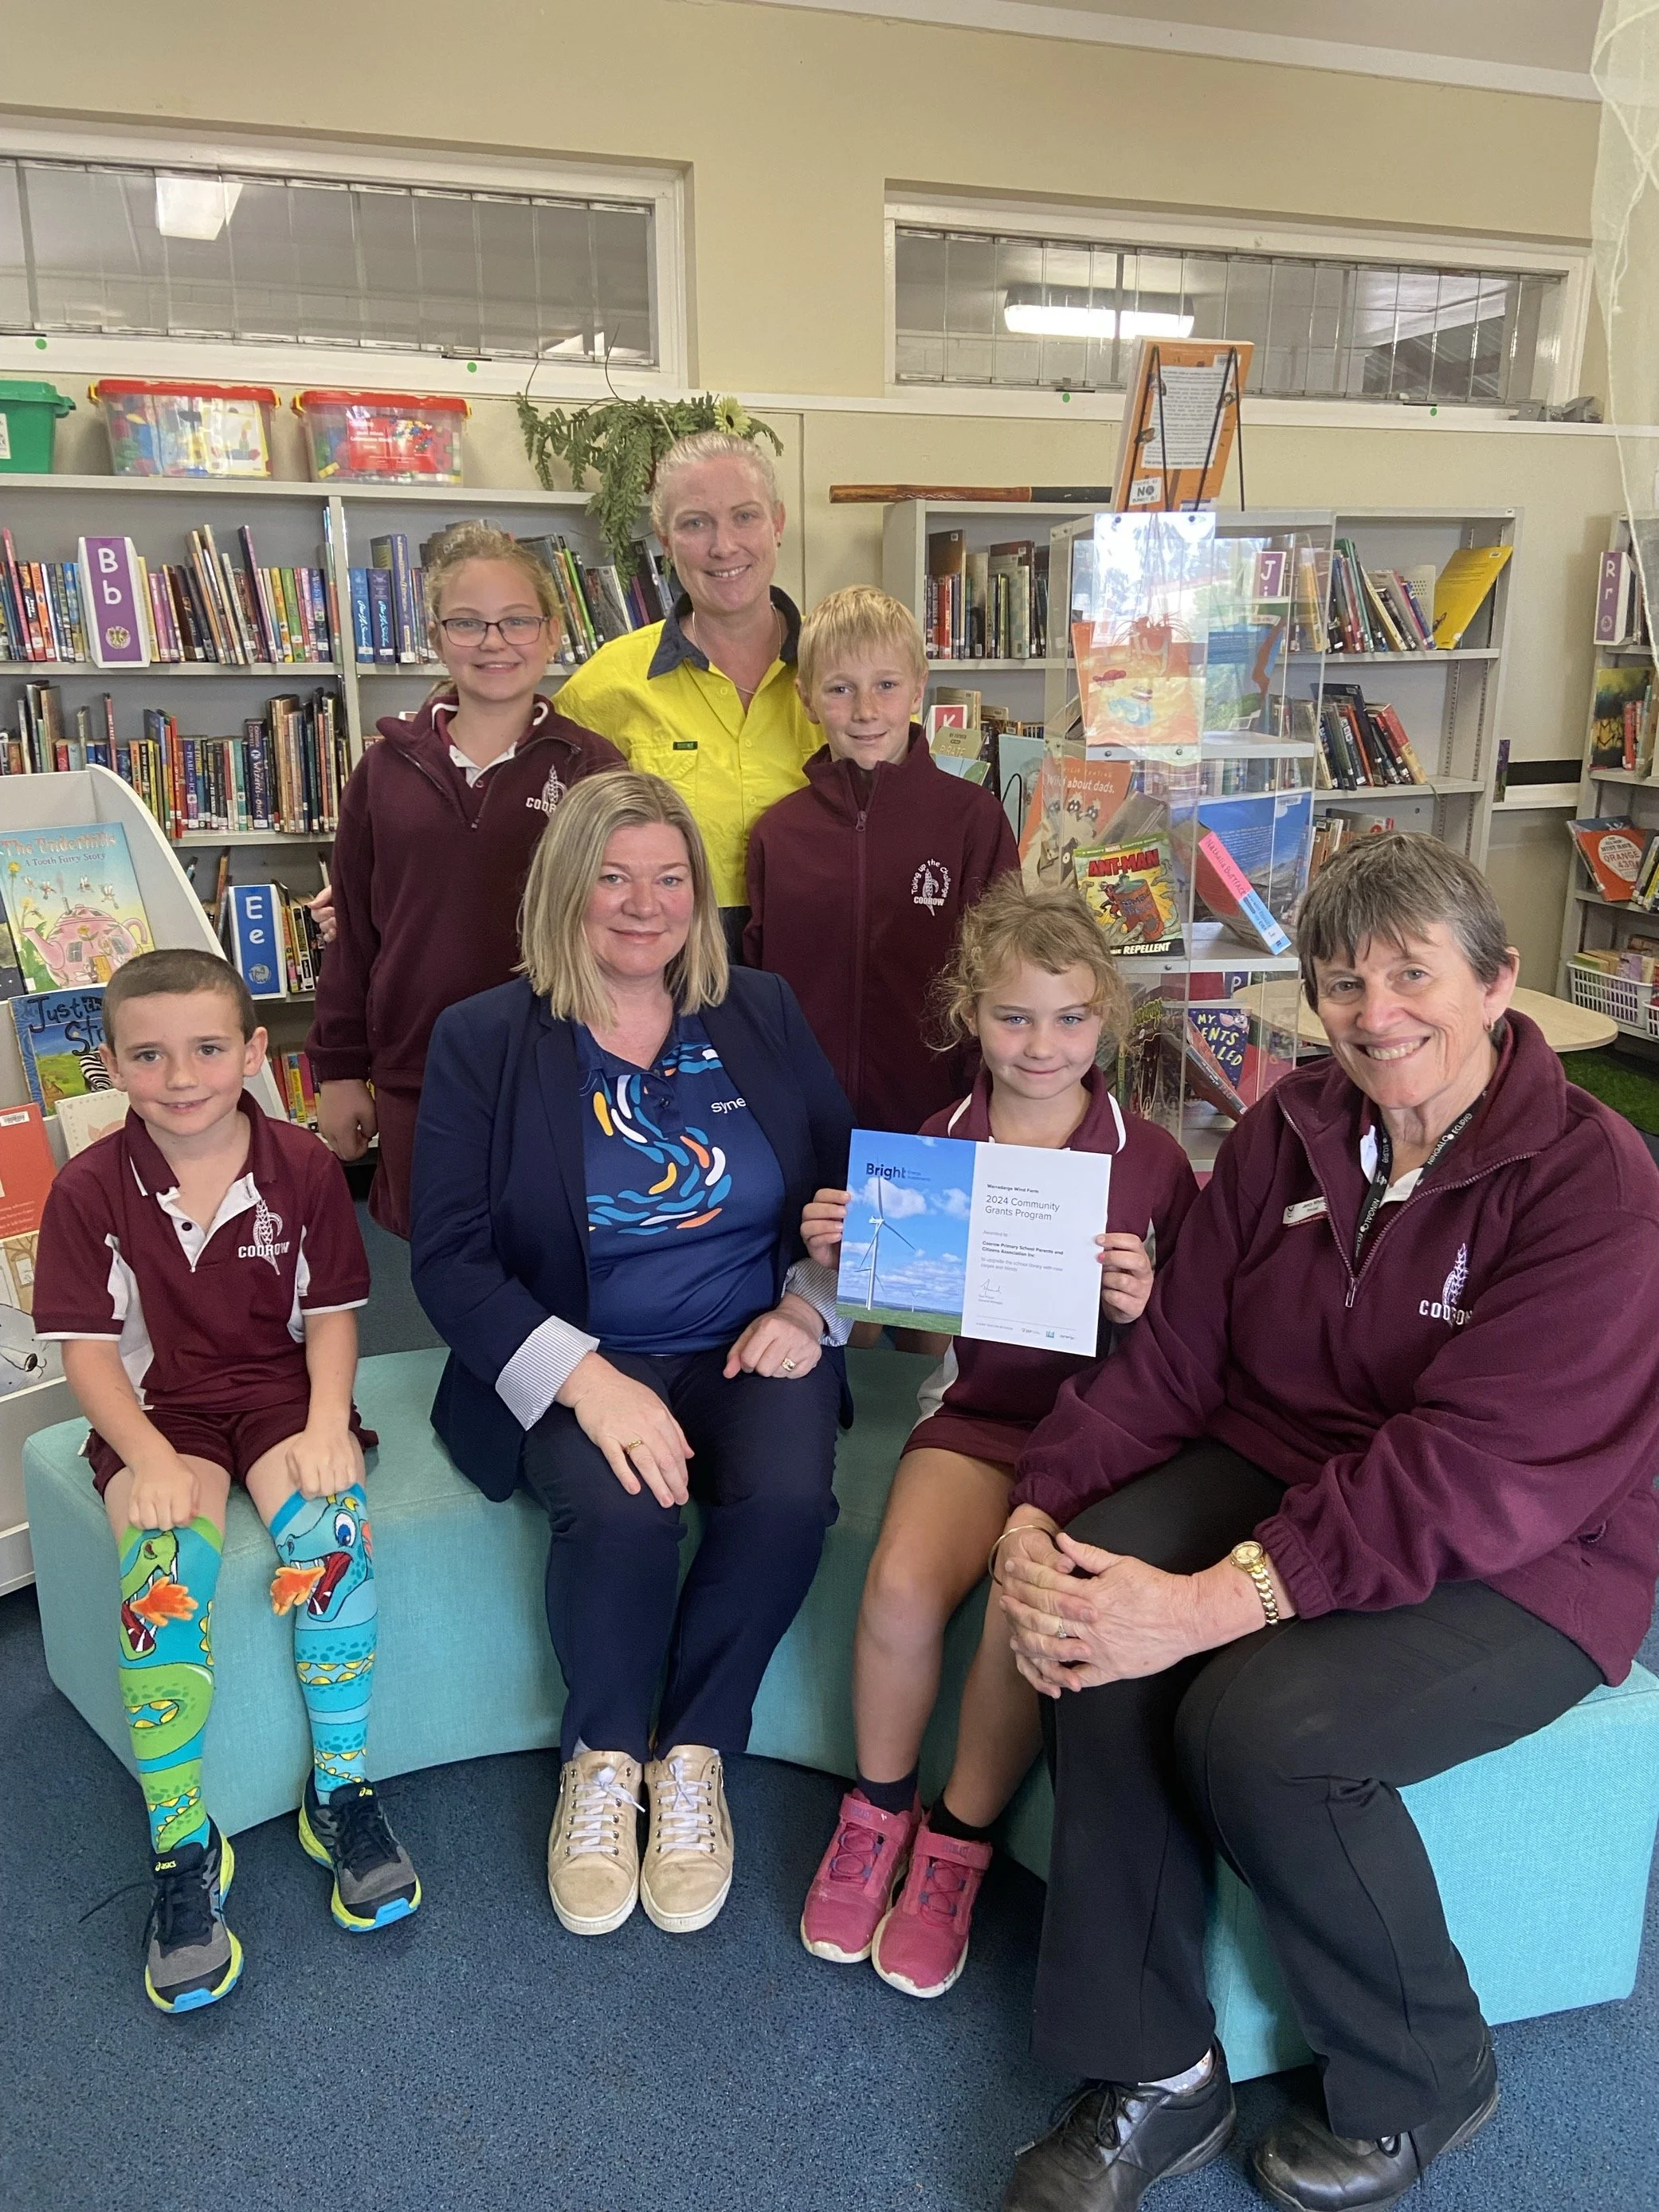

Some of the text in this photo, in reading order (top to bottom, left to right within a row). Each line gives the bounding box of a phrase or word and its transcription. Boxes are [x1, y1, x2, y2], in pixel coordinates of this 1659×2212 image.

[1137, 485, 1155, 496] NO
[98, 548, 119, 574] B
[1606, 560, 1617, 578] R
[1261, 560, 1277, 581] J
[104, 580, 122, 606] b
[1605, 587, 1613, 600] r
[943, 714, 956, 728] K
[1067, 777, 1092, 790] about
[1093, 781, 1115, 794] dads.
[525, 797, 557, 814] COOR
[0, 838, 33, 857] The
[33, 857, 57, 867] Tooth
[83, 853, 106, 861] Story
[1088, 848, 1161, 877] ANT-MAN
[1603, 851, 1641, 862] ORANGE
[911, 872, 922, 895] Taking
[917, 863, 927, 873] up
[927, 858, 940, 868] the
[245, 895, 263, 921] E
[913, 896, 945, 907] COOROW
[249, 928, 265, 944] e
[1123, 941, 1171, 955] REPELLENT
[27, 996, 83, 1033] Just
[1198, 1014, 1217, 1026] MY
[1202, 1026, 1239, 1046] ENTS
[711, 1097, 747, 1114] Syne
[865, 1163, 907, 1181] Bright
[986, 1194, 1061, 1213] 2024 Community
[985, 1206, 1053, 1221] Grants Program
[238, 1241, 290, 1259] COOROW
